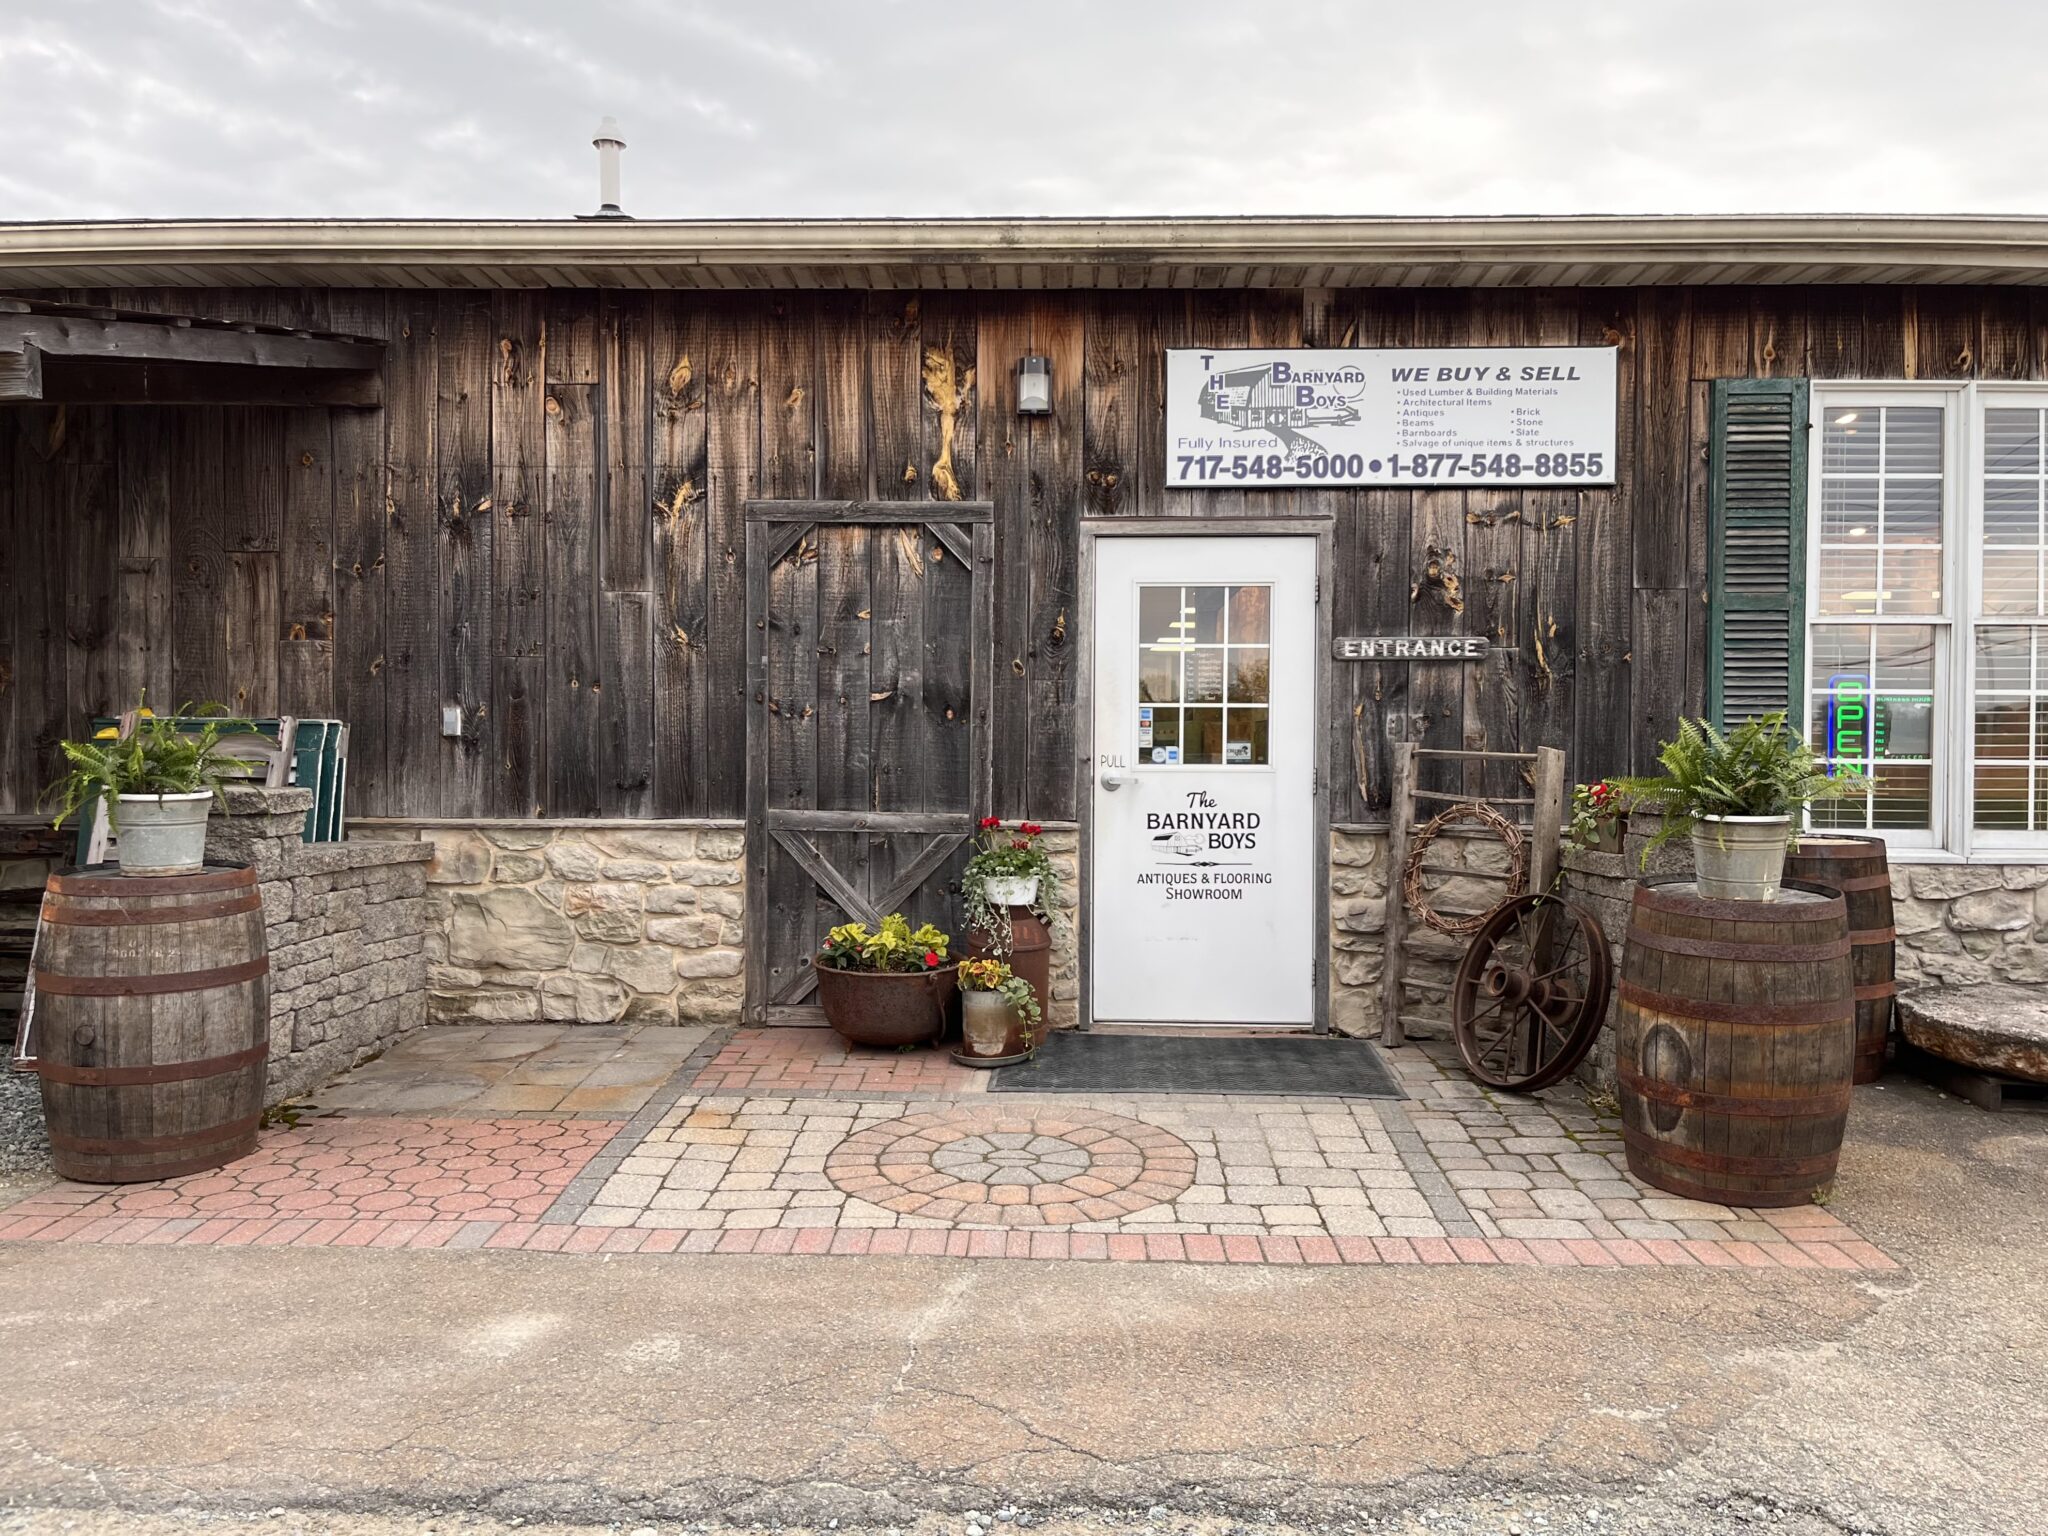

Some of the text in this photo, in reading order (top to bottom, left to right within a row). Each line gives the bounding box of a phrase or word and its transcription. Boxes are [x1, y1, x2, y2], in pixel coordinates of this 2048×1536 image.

[1272, 361, 1365, 384] BARNYARD
[1391, 366, 1581, 382] WE BUY & SELL
[1296, 386, 1347, 407] BOYS
[1402, 387, 1558, 398] Used Lumber & Building Materials
[1403, 398, 1492, 407] Architectural Items
[1403, 409, 1445, 418] Antiques
[1516, 408, 1541, 416] Brick
[1402, 419, 1435, 427] Beams
[1516, 418, 1543, 426] Stone
[1402, 429, 1457, 437] Barnboards
[1516, 428, 1540, 436] Slate
[1178, 437, 1278, 451] Fully Insured
[1402, 438, 1575, 448] Salvage of unique items & structures
[1177, 452, 1603, 480] 717-548-5000 1-877-548-8855
[1344, 639, 1479, 657] ENTRANCE
[1837, 682, 1864, 777] OPEN
[1100, 754, 1127, 768] PULL
[1186, 790, 1218, 809] The
[1146, 812, 1261, 830] BARNYARD
[1208, 832, 1256, 849] BOYS
[1136, 873, 1273, 886] ANTIQUES & FLOORING
[1165, 887, 1243, 900] SHOWROOM
